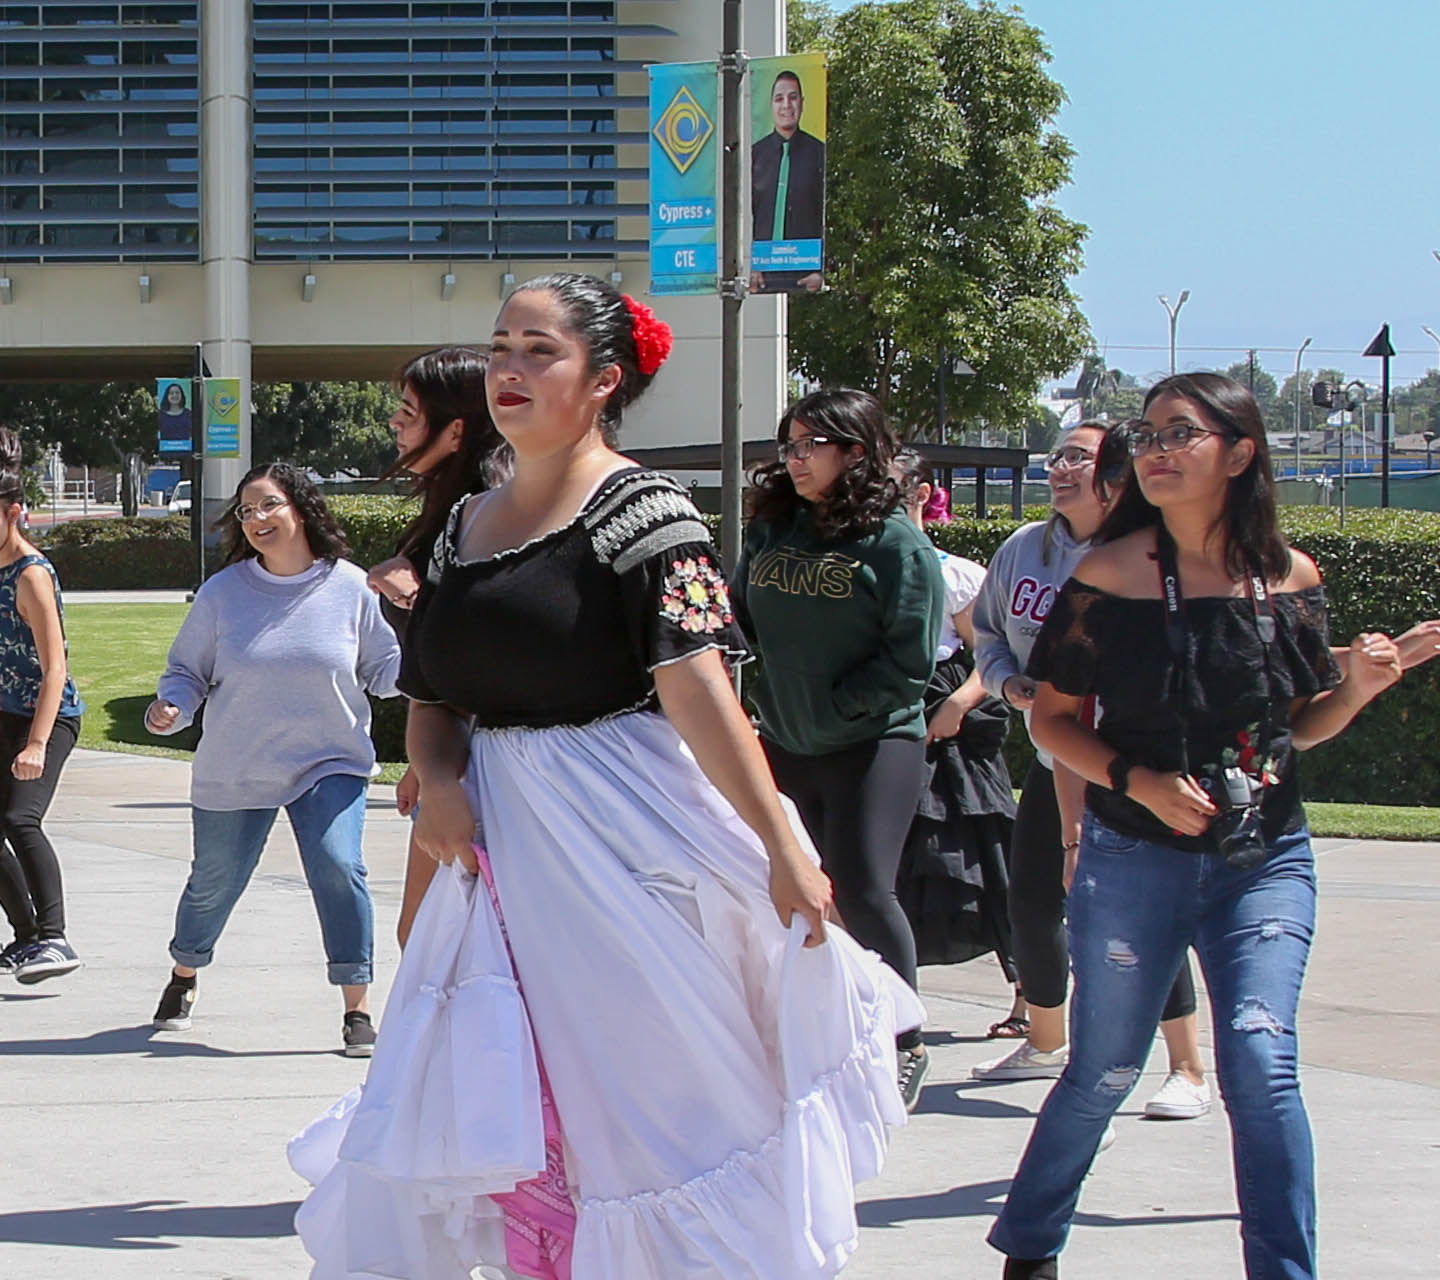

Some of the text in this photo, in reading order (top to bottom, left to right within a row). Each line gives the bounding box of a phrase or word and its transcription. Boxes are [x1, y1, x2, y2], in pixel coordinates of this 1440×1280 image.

[659, 203, 703, 224] Cypress
[674, 250, 696, 268] CTE
[1165, 576, 1177, 612] Canon
